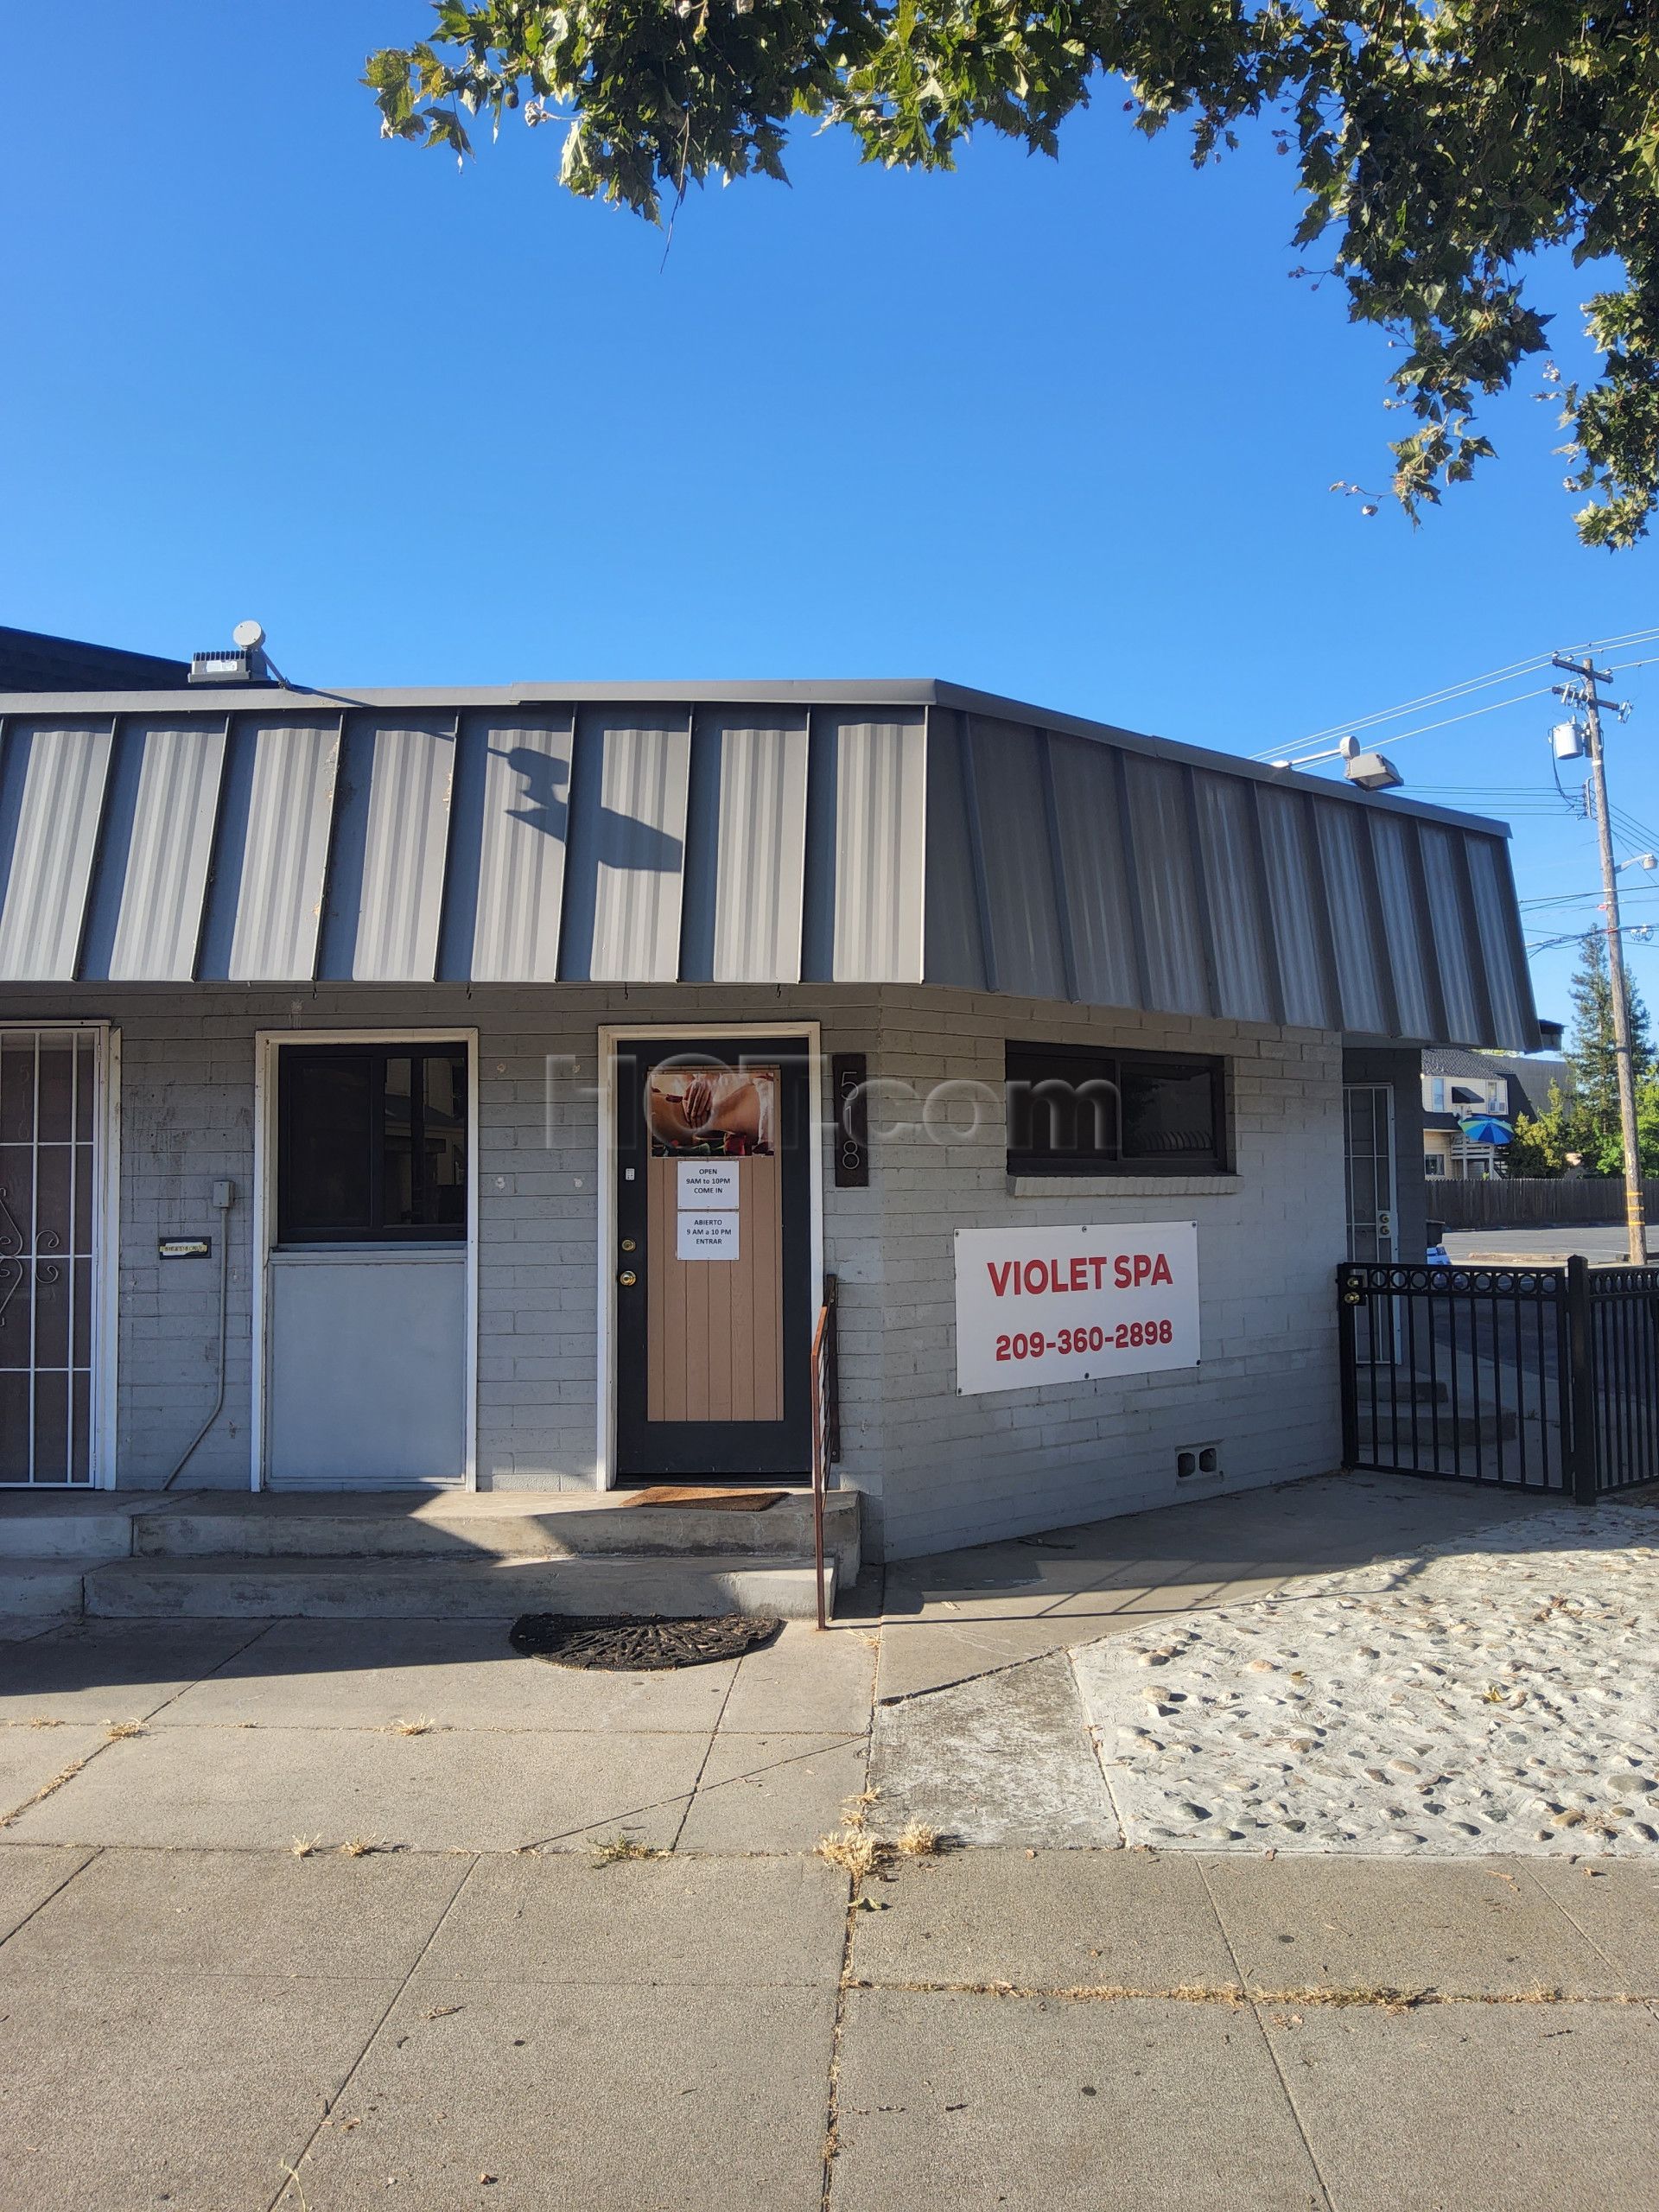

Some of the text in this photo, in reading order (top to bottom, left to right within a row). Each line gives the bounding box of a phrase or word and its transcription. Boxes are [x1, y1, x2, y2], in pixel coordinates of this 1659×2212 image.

[841, 1071, 860, 1170] 518
[986, 1253, 1173, 1298] VIOLET SPA
[995, 1319, 1173, 1362] 209-360-2898
